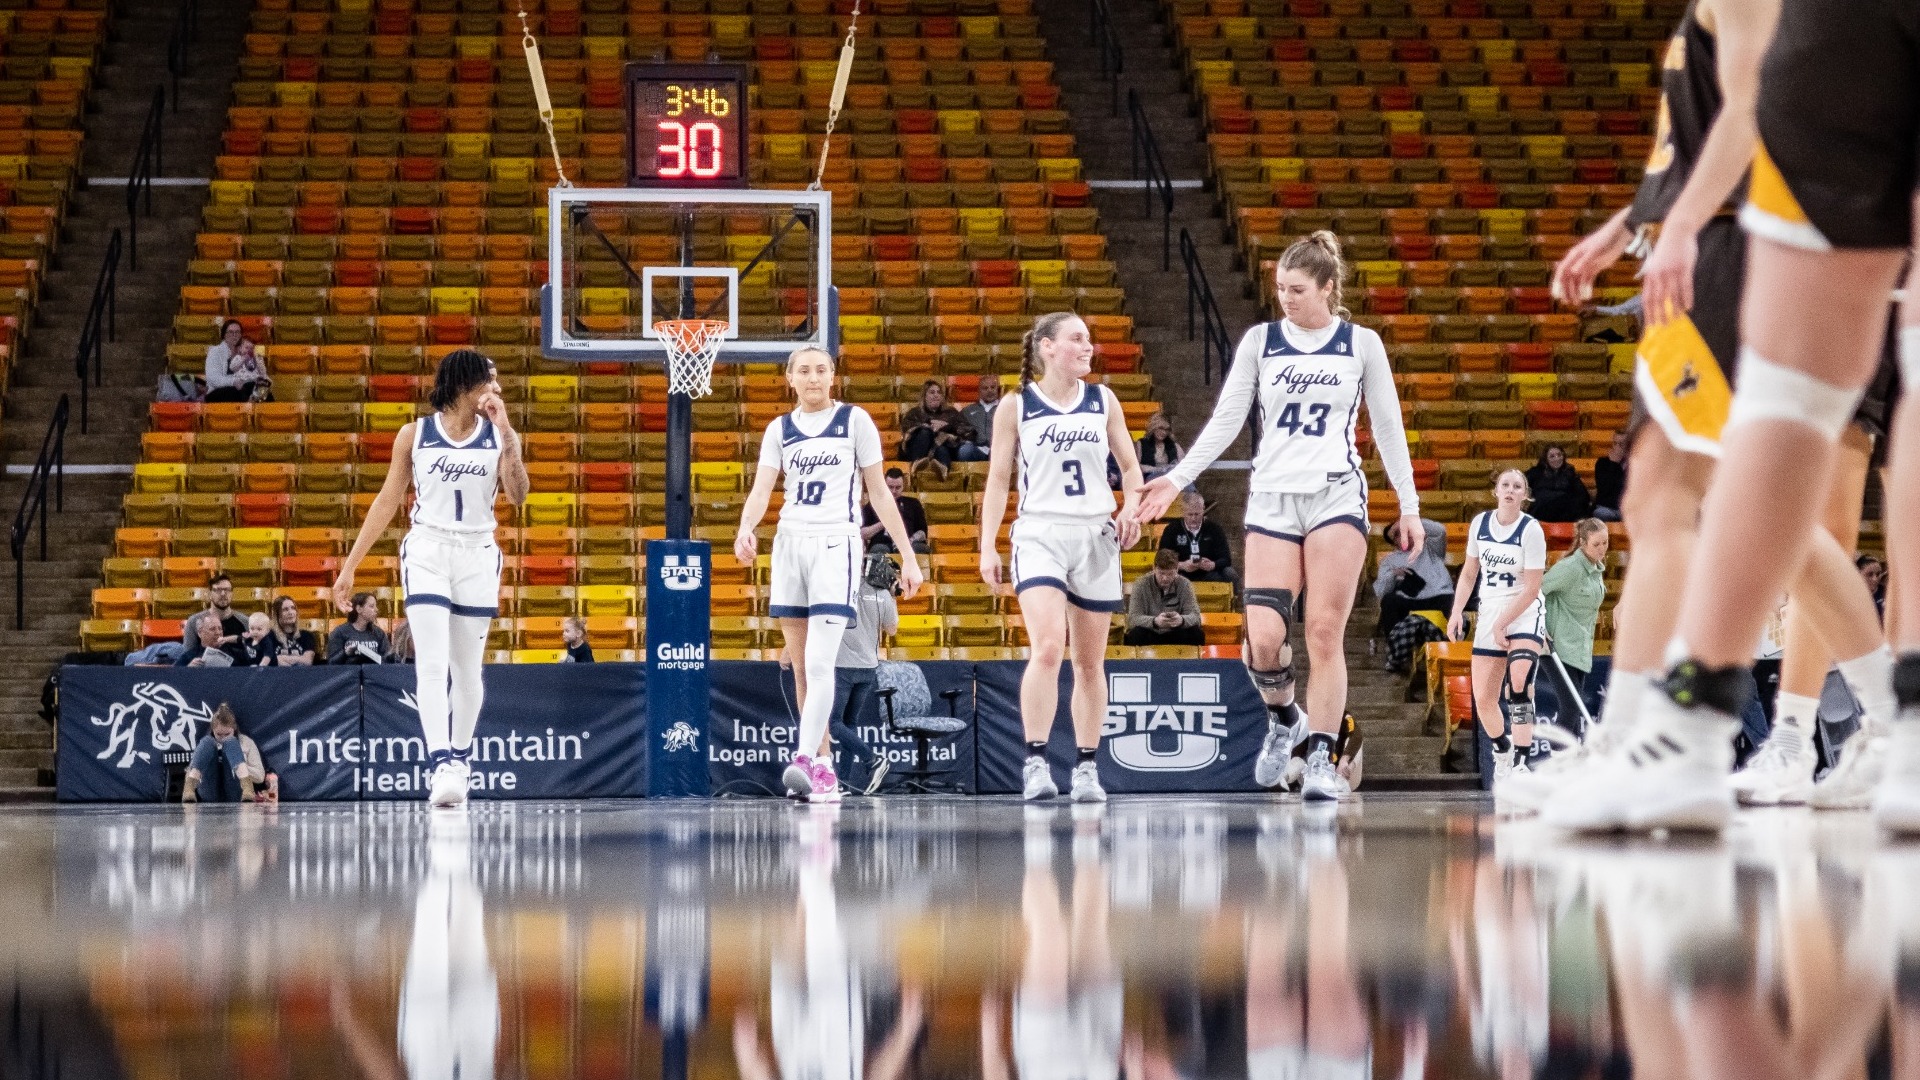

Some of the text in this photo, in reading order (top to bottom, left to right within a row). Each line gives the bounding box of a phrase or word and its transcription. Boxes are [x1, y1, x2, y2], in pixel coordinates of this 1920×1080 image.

[666, 85, 730, 116] 3:46
[657, 121, 723, 177] 30
[1271, 364, 1342, 394] Aggies
[1276, 402, 1332, 437] 43
[1036, 423, 1101, 453] Aggies
[427, 454, 489, 483] Aggies
[788, 448, 842, 476] Aggies
[1061, 459, 1087, 497] 3
[454, 489, 464, 522] 1
[793, 480, 827, 506] 10
[1480, 547, 1517, 568] Aggies
[660, 566, 703, 579] STATE
[1486, 570, 1517, 588] 24
[657, 643, 705, 661] Guild
[657, 661, 705, 670] mortgage
[1100, 705, 1228, 737] STATE
[709, 745, 771, 766] Logan
[873, 743, 957, 766] Hosptal
[353, 765, 517, 793] Healtare
